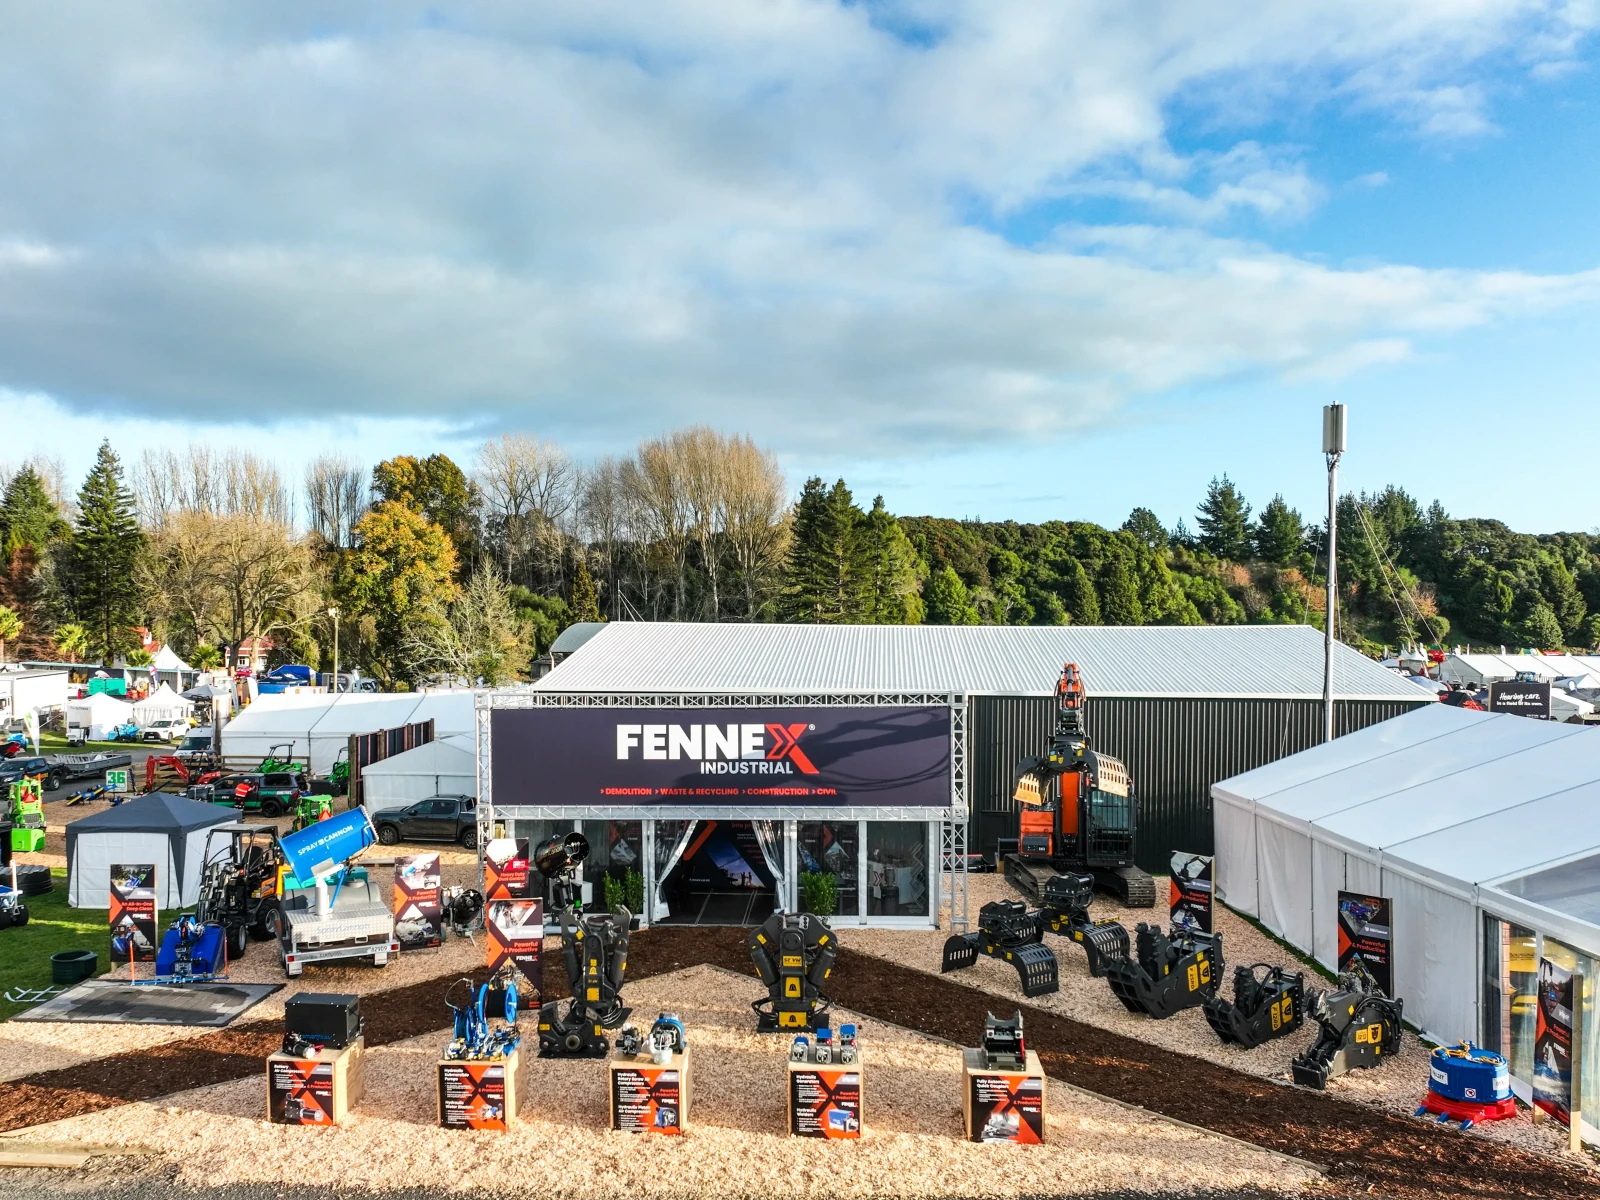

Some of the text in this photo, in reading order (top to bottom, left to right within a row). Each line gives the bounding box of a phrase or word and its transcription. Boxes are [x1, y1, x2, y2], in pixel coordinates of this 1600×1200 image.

[1499, 692, 1523, 702] Hearing
[701, 762, 793, 774] INDUSTRIAL
[108, 771, 125, 783] 36
[298, 825, 354, 856] SPRAY CANNON
[1357, 944, 1386, 953] Productive
[1362, 939, 1386, 947] Powerful
